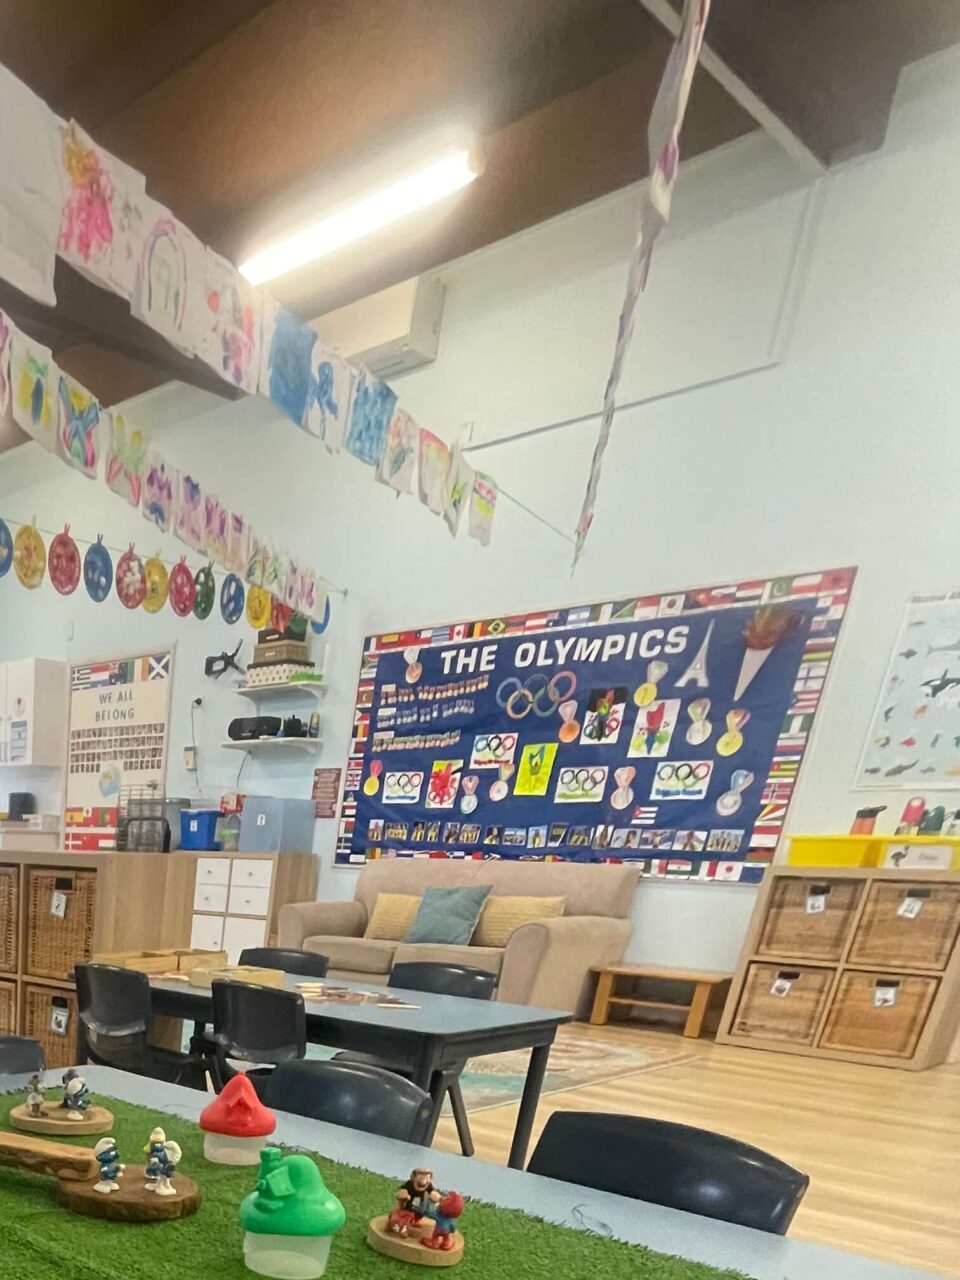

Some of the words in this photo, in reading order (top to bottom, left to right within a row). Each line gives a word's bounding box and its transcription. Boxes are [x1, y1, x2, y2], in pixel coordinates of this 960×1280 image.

[441, 645, 498, 674] THE
[514, 626, 690, 668] OLYMPICS
[99, 692, 113, 704] WE
[117, 689, 133, 702] ALL
[95, 707, 135, 722] BELONG
